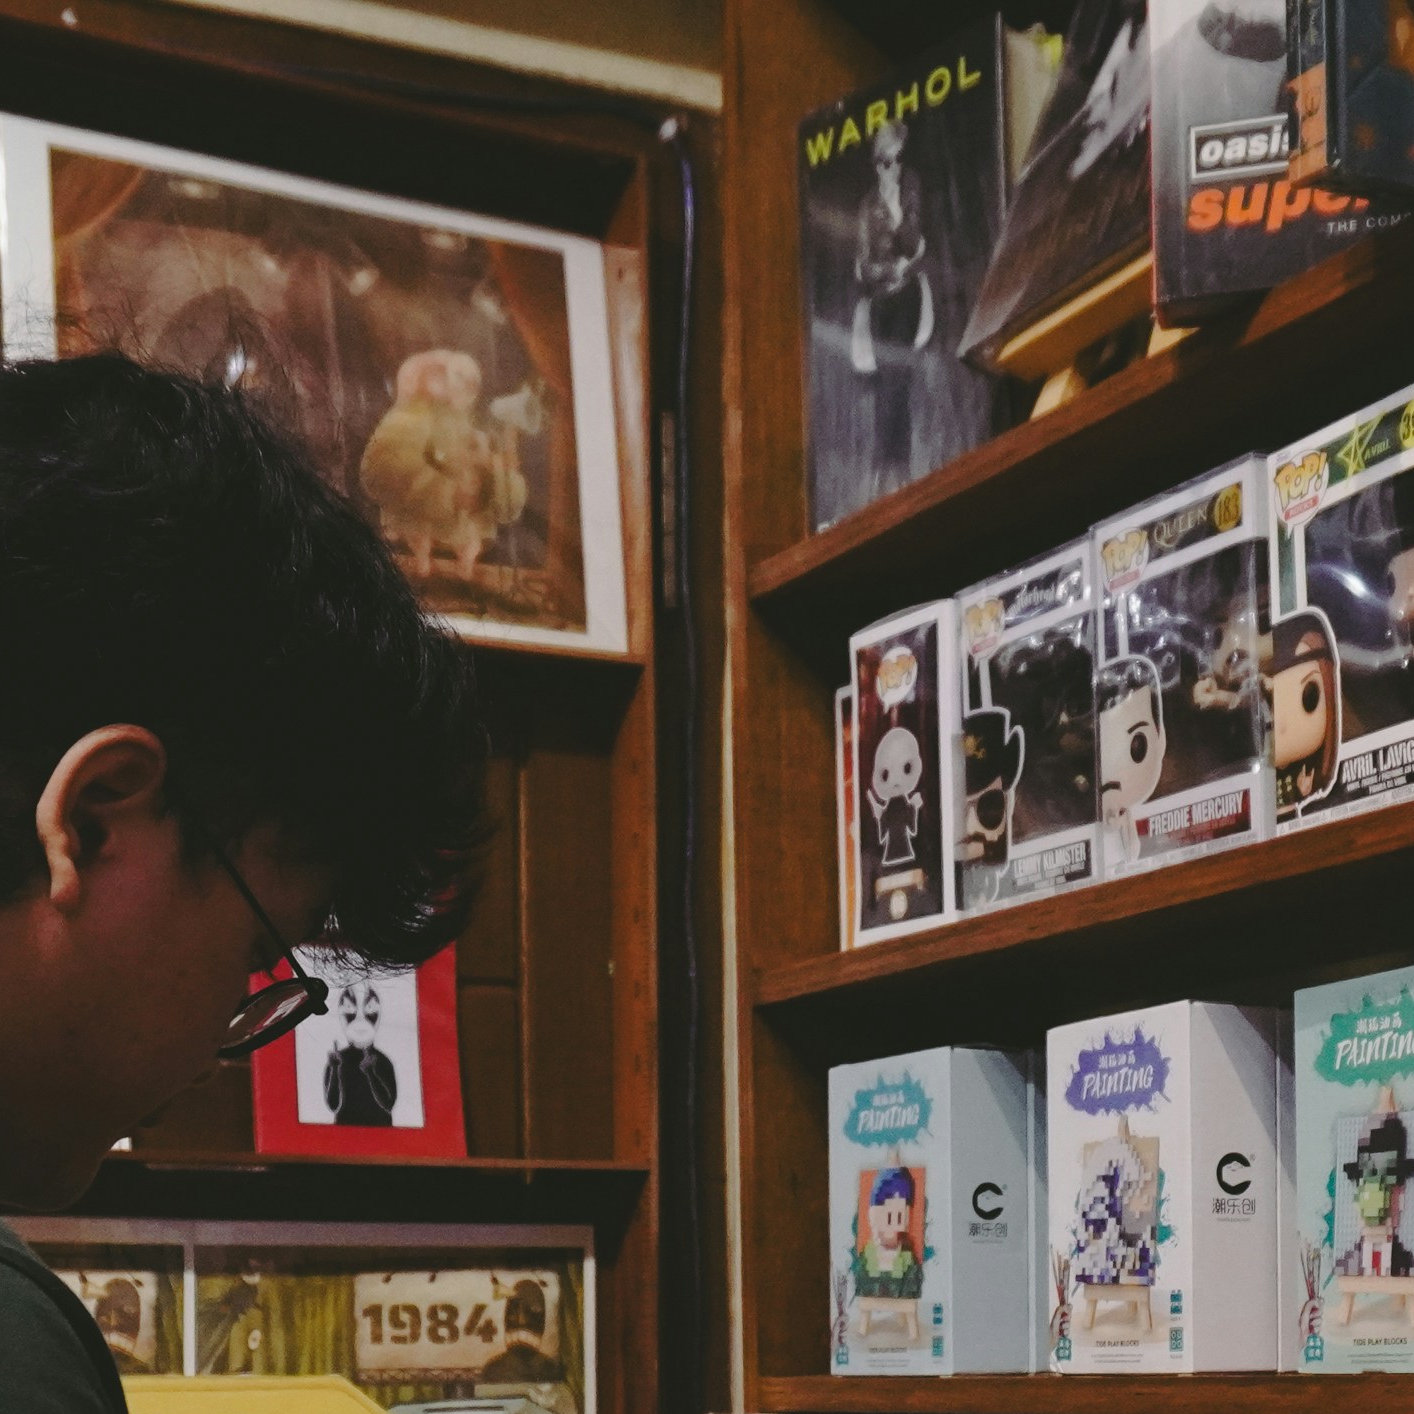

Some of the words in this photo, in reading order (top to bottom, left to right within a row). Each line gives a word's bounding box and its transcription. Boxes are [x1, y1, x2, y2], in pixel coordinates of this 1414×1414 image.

[804, 55, 982, 166] WARHOL
[1274, 452, 1327, 501] POP!
[1153, 508, 1208, 546] QUEEN
[1148, 804, 1190, 836] FREDDIE
[1193, 790, 1244, 826] MERCURY
[1083, 1067, 1154, 1100] PAINTING
[858, 1103, 919, 1134] PAINTING
[362, 1303, 497, 1345] 1984
